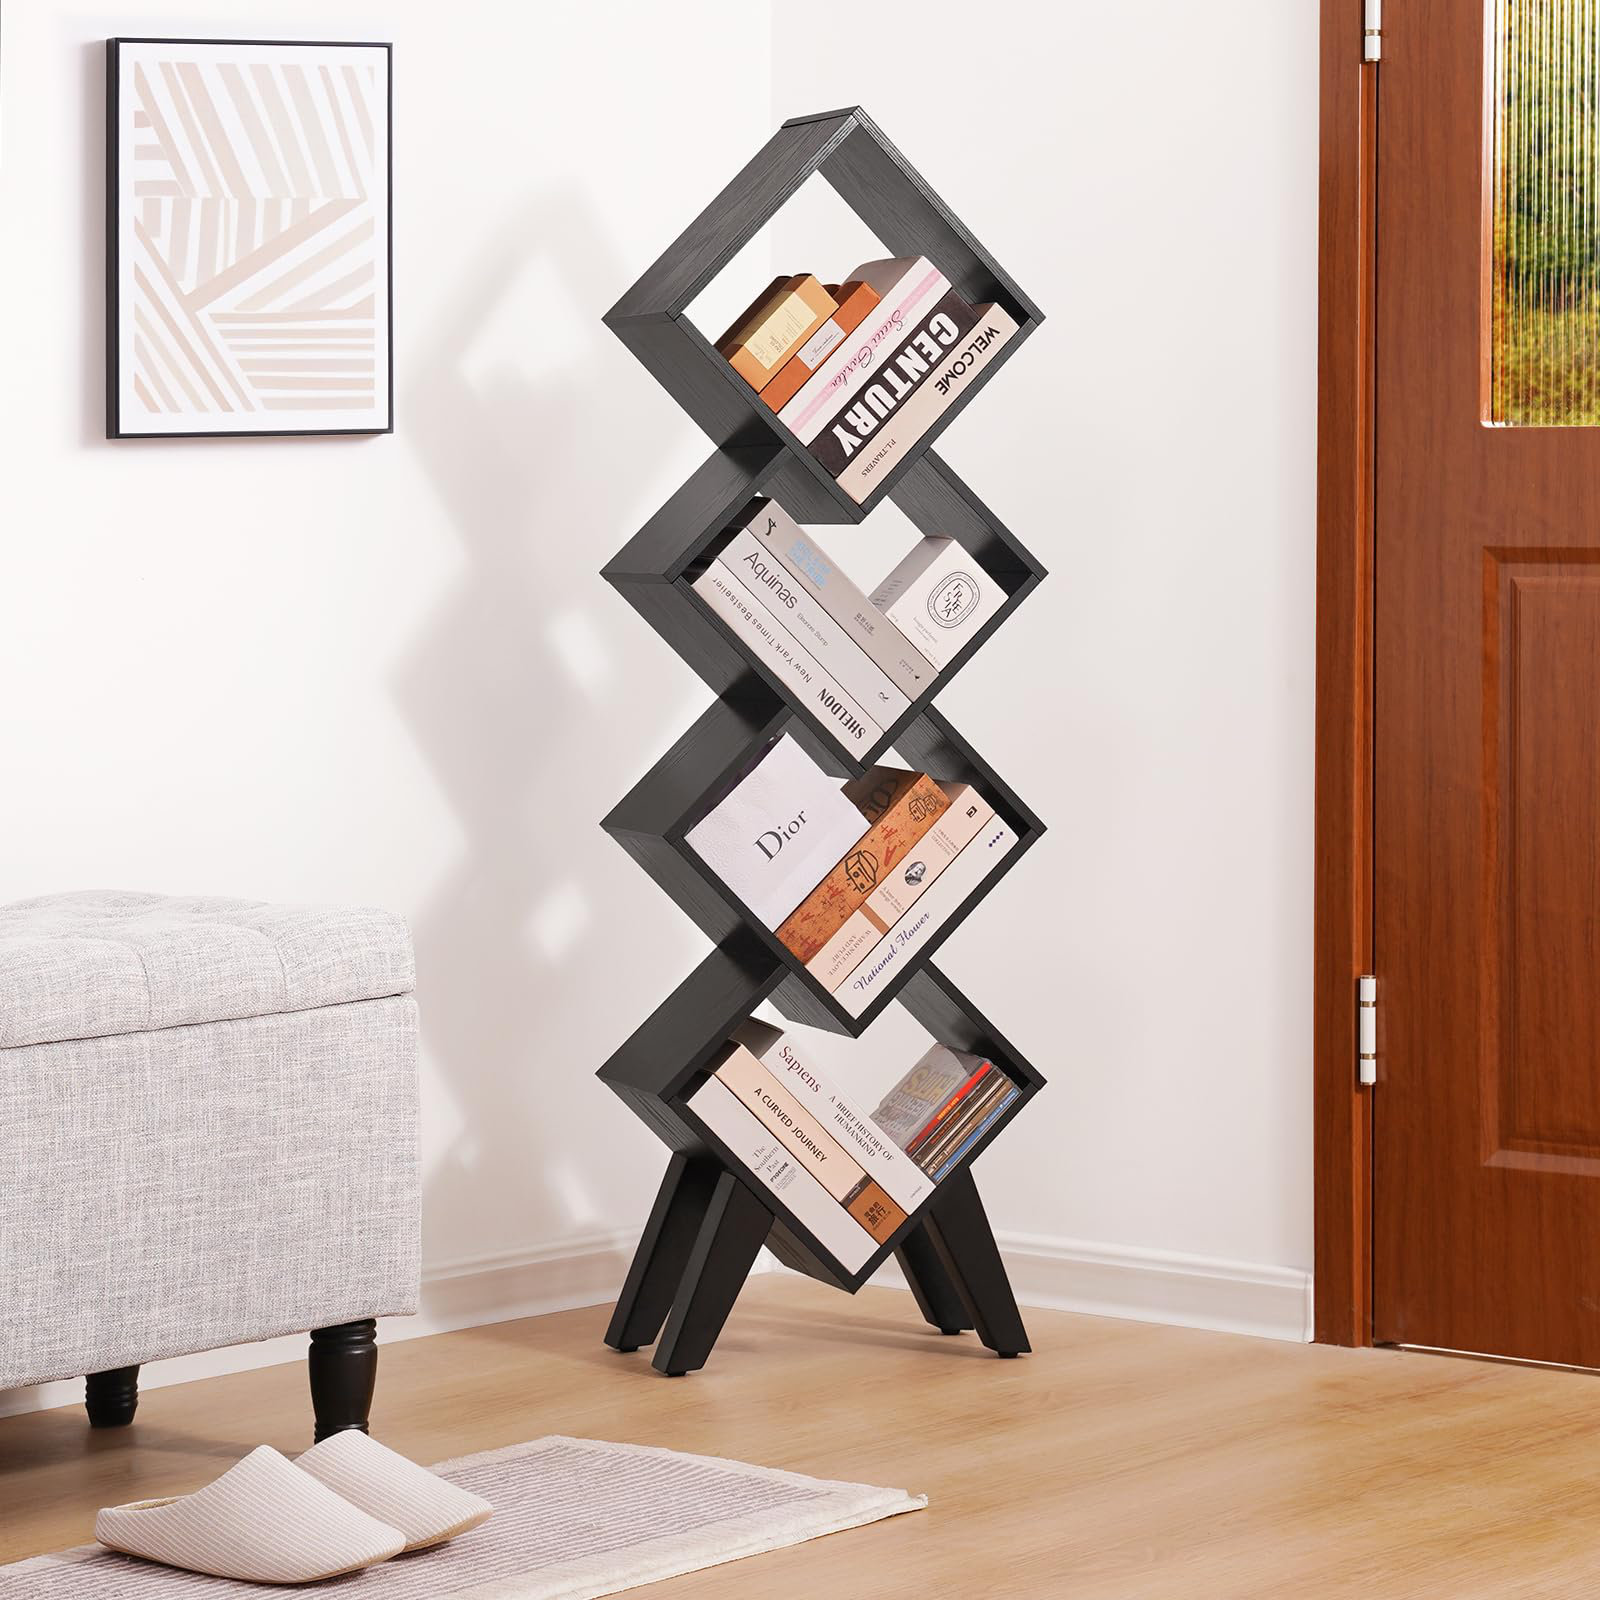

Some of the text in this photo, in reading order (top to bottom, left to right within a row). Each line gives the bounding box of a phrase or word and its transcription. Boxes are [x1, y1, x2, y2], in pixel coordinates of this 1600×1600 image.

[831, 345, 874, 386] Garden
[832, 312, 959, 457] CENTURY
[934, 326, 1000, 395] WELCOME
[743, 552, 798, 609] Aquinas
[751, 618, 775, 647] Times
[794, 662, 812, 683] New
[817, 687, 866, 740] SHELDON
[753, 809, 810, 863] Dior
[853, 944, 898, 990] National
[895, 911, 930, 946] Flower
[778, 1045, 822, 1094] Sapiens
[754, 1087, 828, 1163] A CURVED JOURNEY
[834, 1113, 876, 1157] HUMANKIND
[836, 1102, 857, 1122] BRIEF
[855, 1121, 885, 1152] HISTORY
[882, 1150, 894, 1160] OF
[754, 1146, 779, 1172] Southern
